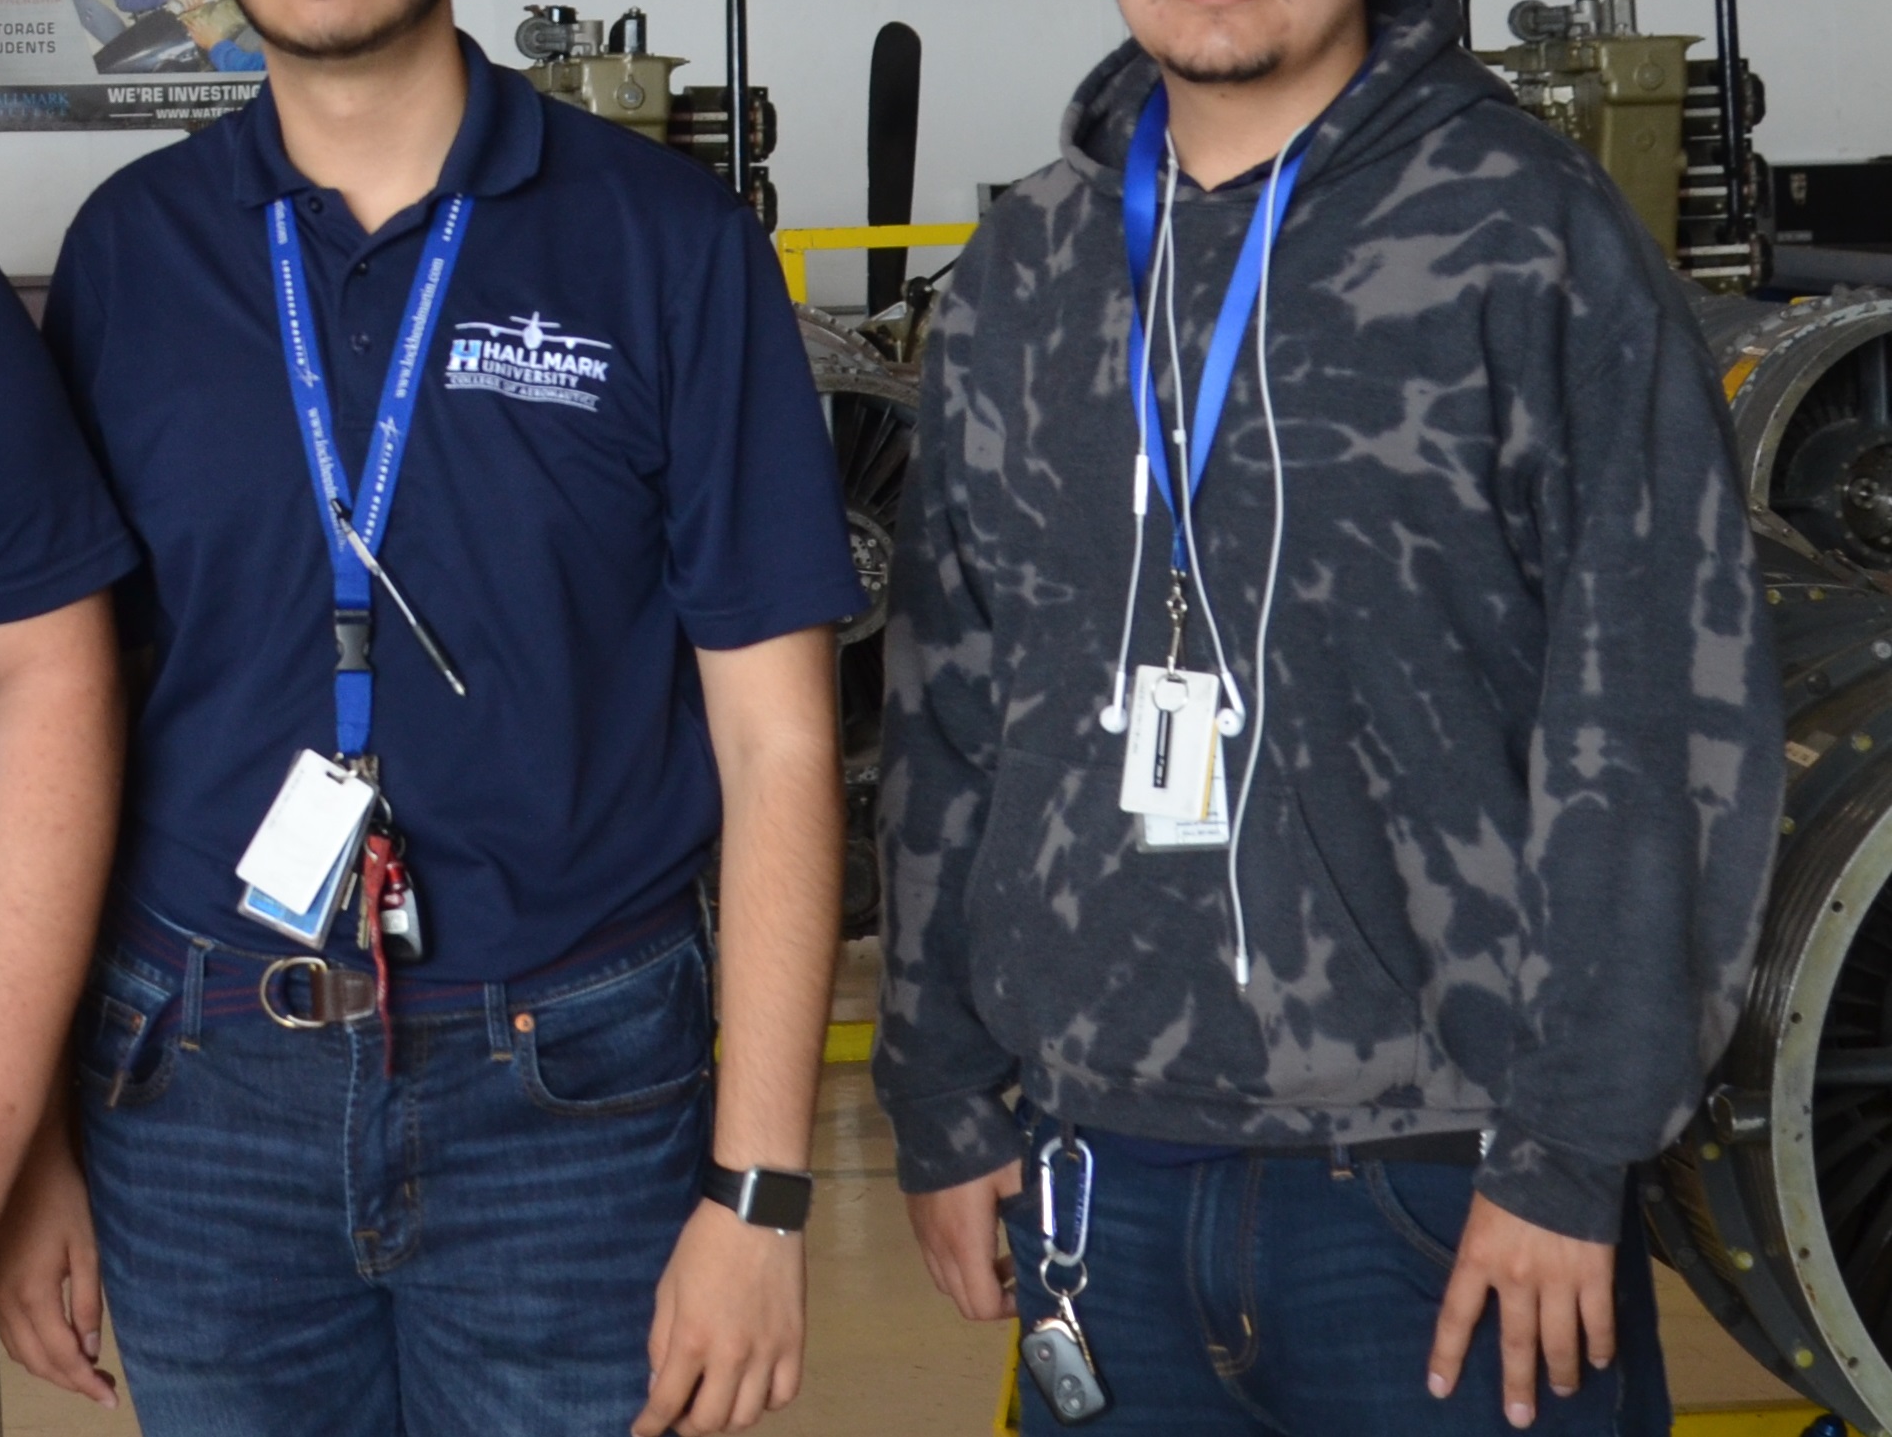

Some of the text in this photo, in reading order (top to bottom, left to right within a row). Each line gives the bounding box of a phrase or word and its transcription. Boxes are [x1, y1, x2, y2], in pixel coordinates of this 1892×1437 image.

[108, 87, 163, 103] WE'RE
[482, 359, 579, 388] UNIVERSITY
[483, 340, 609, 382] HALLMARK
